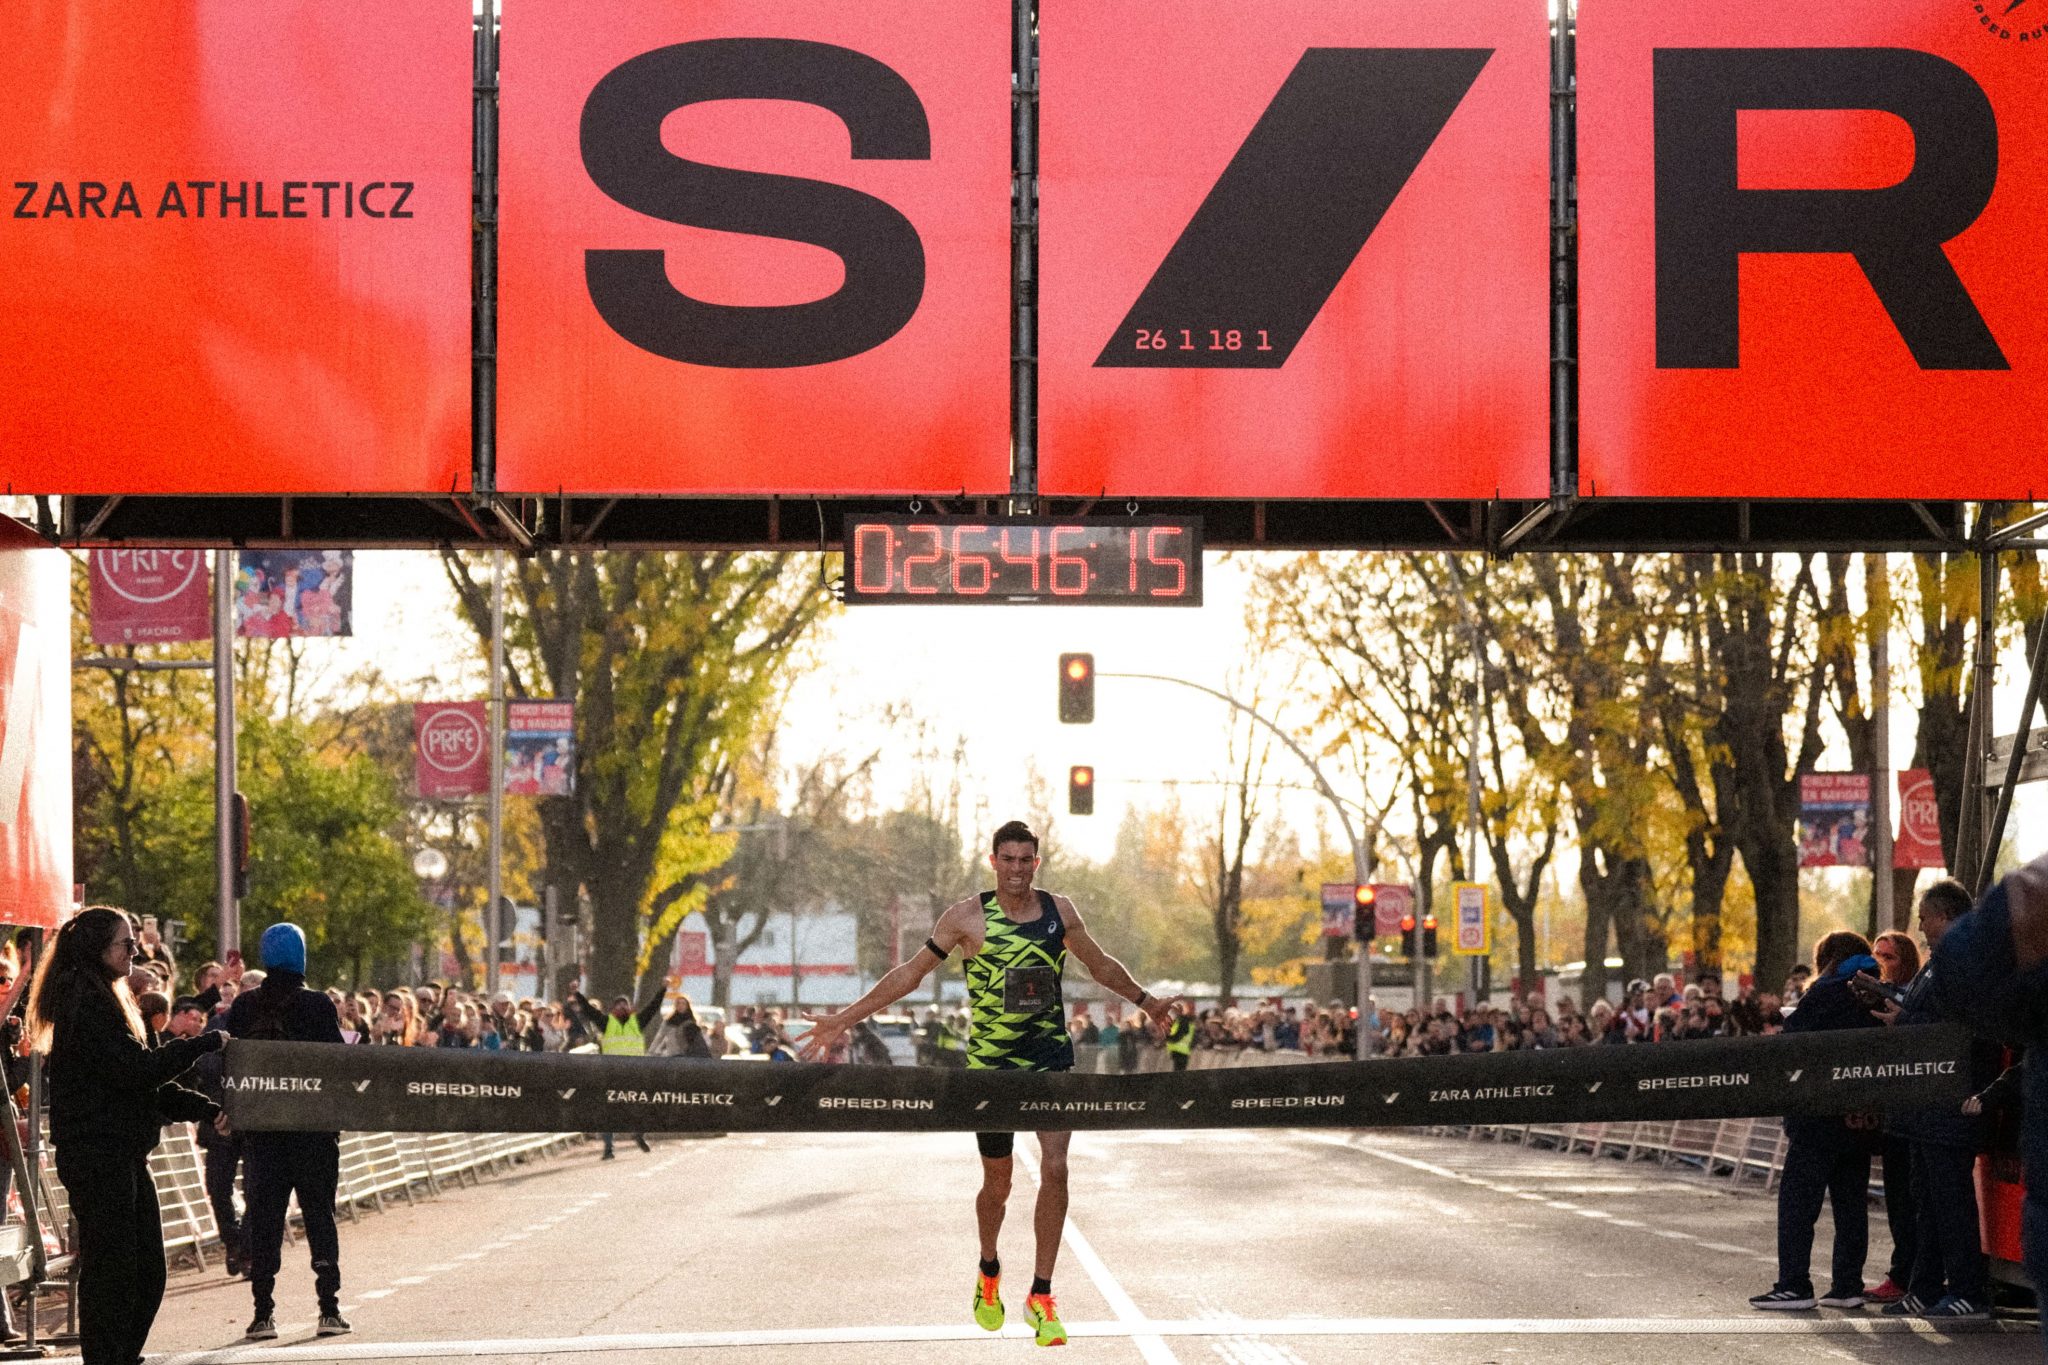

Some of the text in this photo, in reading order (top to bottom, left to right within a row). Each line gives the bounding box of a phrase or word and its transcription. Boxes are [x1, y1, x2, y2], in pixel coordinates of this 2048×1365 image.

[14, 181, 415, 218] ZARA ATHLETICZ
[1135, 329, 1272, 351] 26 1 18 1
[137, 626, 181, 637] MADRID
[239, 1076, 322, 1092] ATHLETICZ
[407, 1081, 476, 1097] SPEED
[479, 1085, 522, 1098] RUN
[606, 1090, 649, 1103] ZARA
[652, 1091, 735, 1106] ATHLETICZ
[818, 1097, 888, 1110] SPEED
[891, 1098, 934, 1110] RUN
[1019, 1101, 1061, 1111] ZARA
[1064, 1101, 1146, 1111] ATHLETICZ
[1231, 1096, 1299, 1109] SPEED
[1303, 1094, 1345, 1107] RUN
[1429, 1089, 1471, 1102] ZARA
[1473, 1084, 1555, 1100] ATHLETICZ
[1637, 1075, 1705, 1091] SPEED
[1708, 1073, 1750, 1087] RUN
[1832, 1066, 1874, 1081] ZARA
[1876, 1060, 1956, 1077] ATHLETICZ
